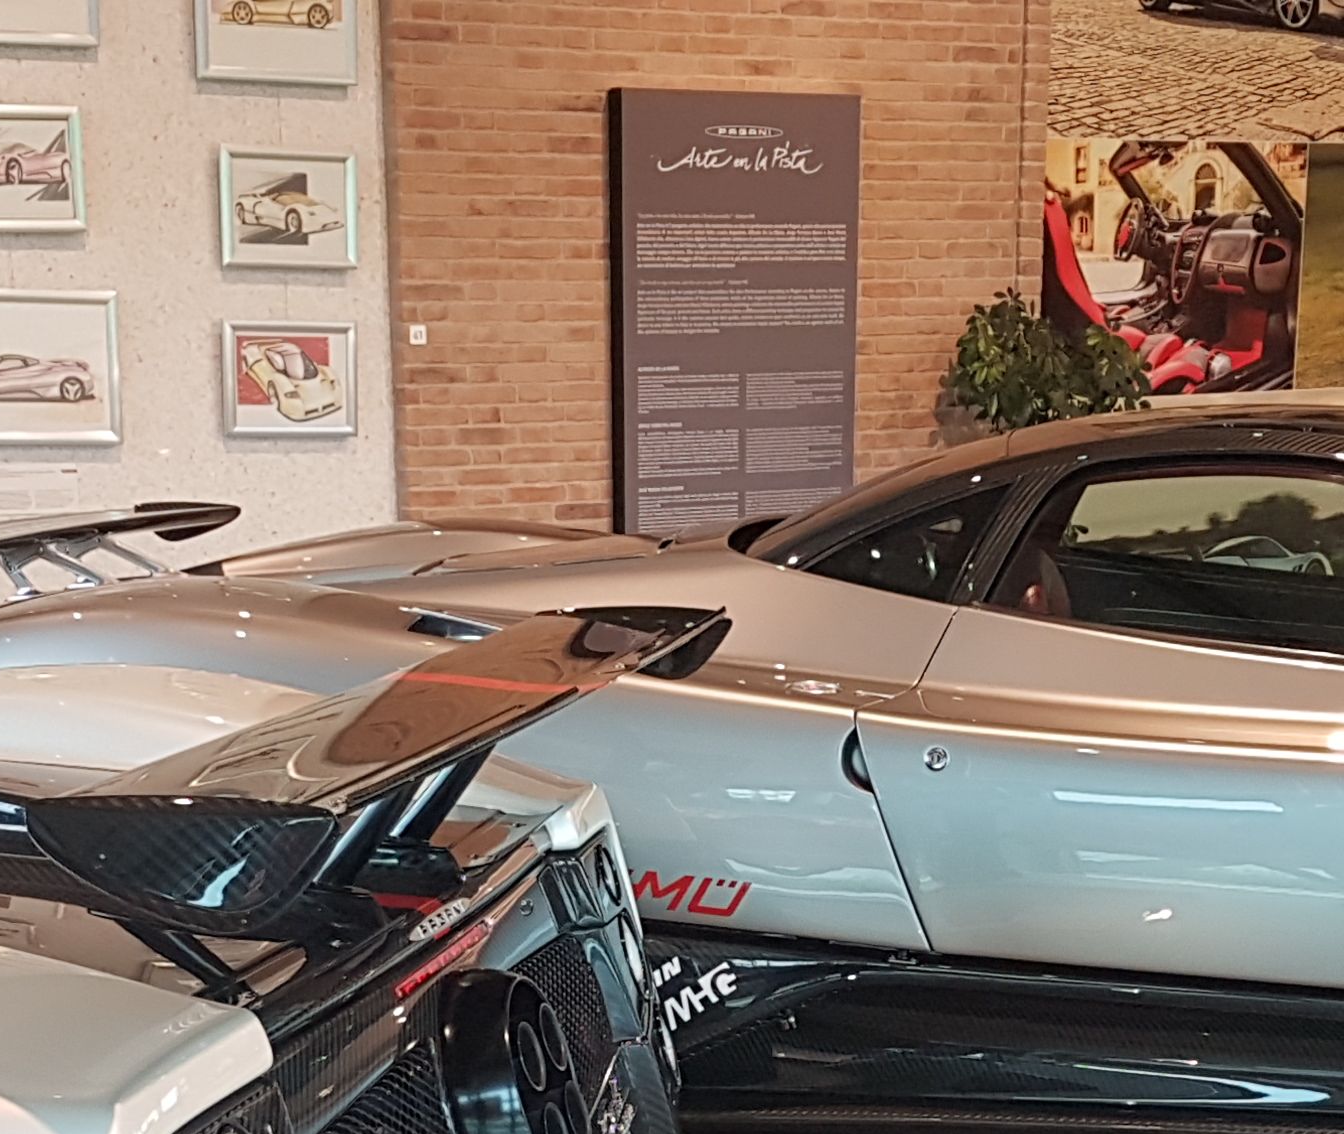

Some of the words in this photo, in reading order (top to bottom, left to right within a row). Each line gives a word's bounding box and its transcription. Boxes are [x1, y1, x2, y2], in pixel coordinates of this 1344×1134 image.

[717, 127, 772, 136] PAGANI
[657, 146, 732, 172] Arte
[733, 155, 752, 171] en
[754, 147, 768, 172] la
[771, 140, 824, 174] Pista
[628, 868, 752, 917] MÜ
